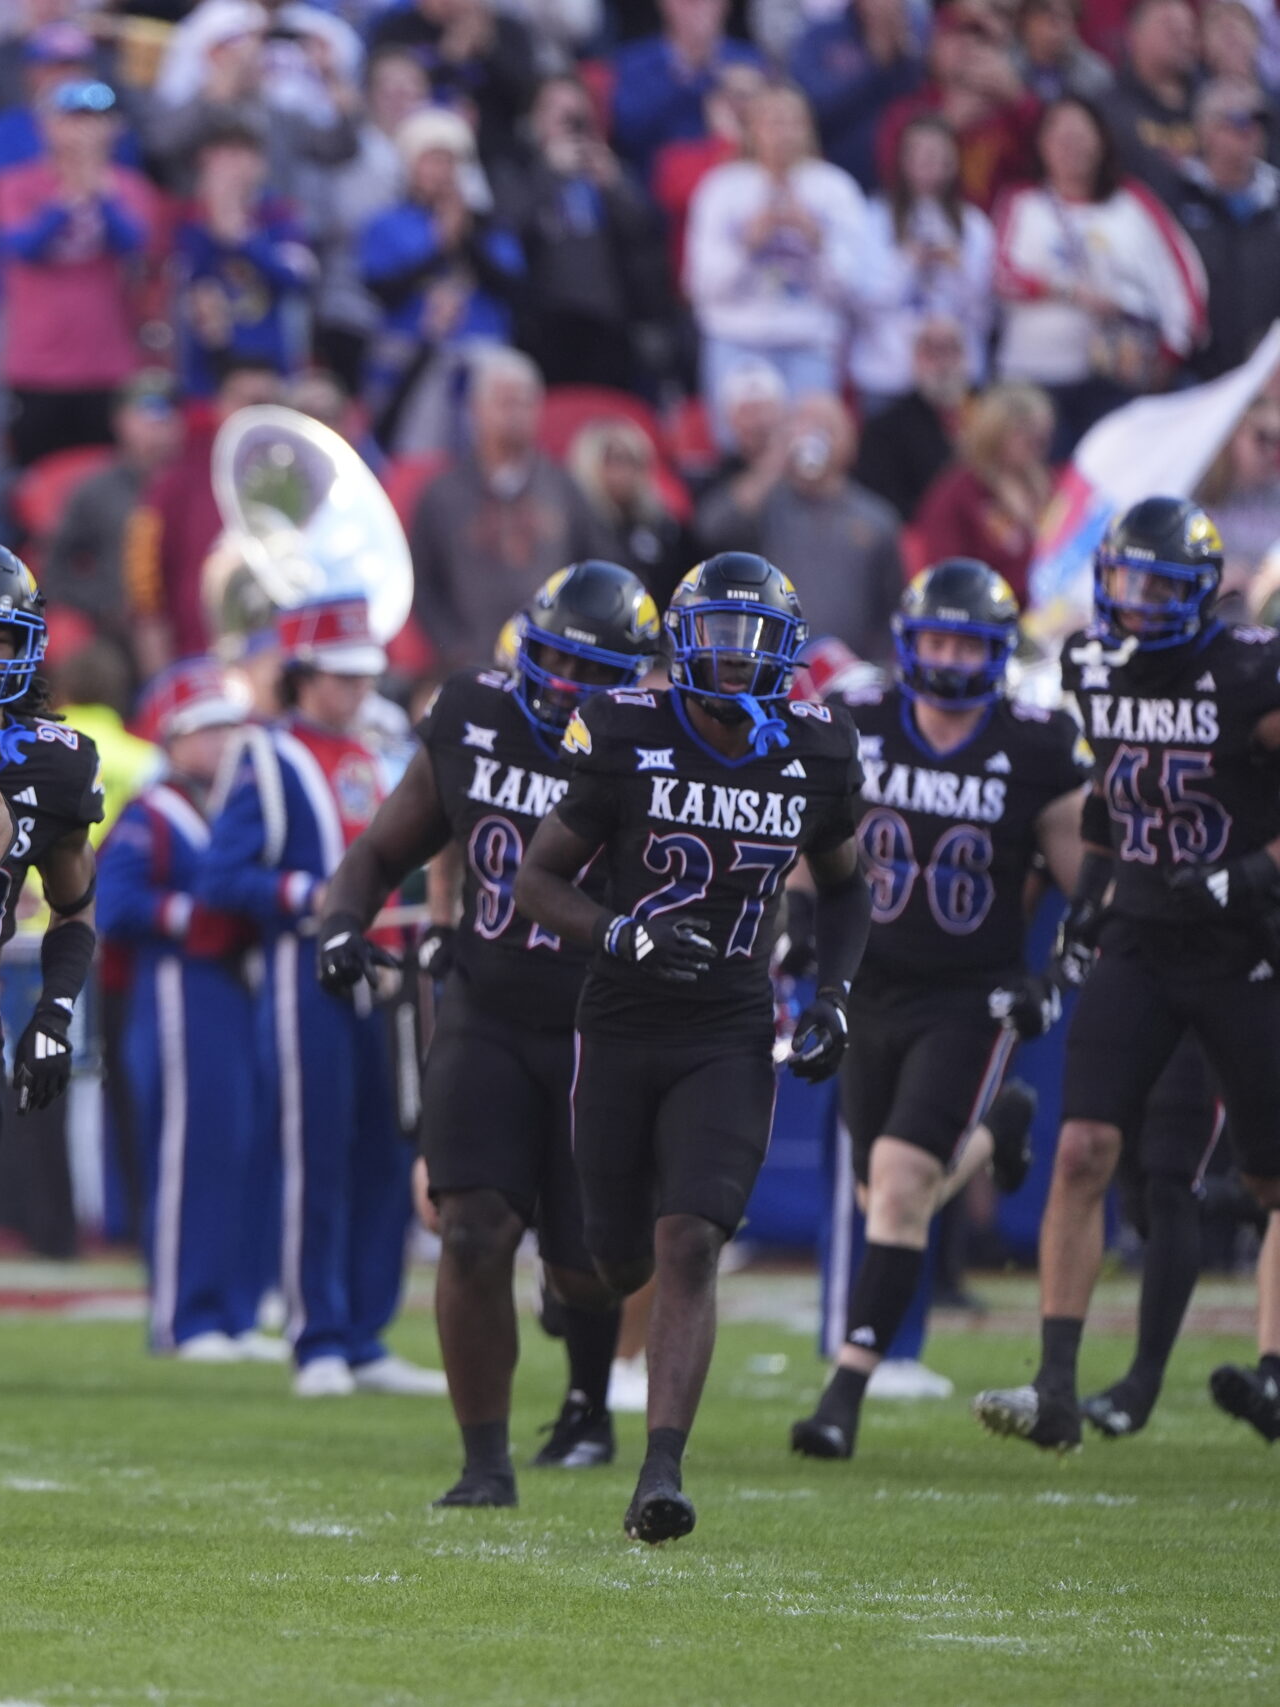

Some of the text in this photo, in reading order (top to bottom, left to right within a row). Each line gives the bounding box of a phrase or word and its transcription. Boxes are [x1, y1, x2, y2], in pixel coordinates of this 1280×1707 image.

[1090, 693, 1220, 744] KANSAS
[468, 755, 569, 818] KANS
[635, 748, 676, 770] XII
[648, 776, 807, 838] KANSAS
[861, 762, 1007, 824] KANSAS
[1104, 744, 1232, 865] 45
[632, 831, 798, 959] 27
[856, 806, 996, 935] 96
